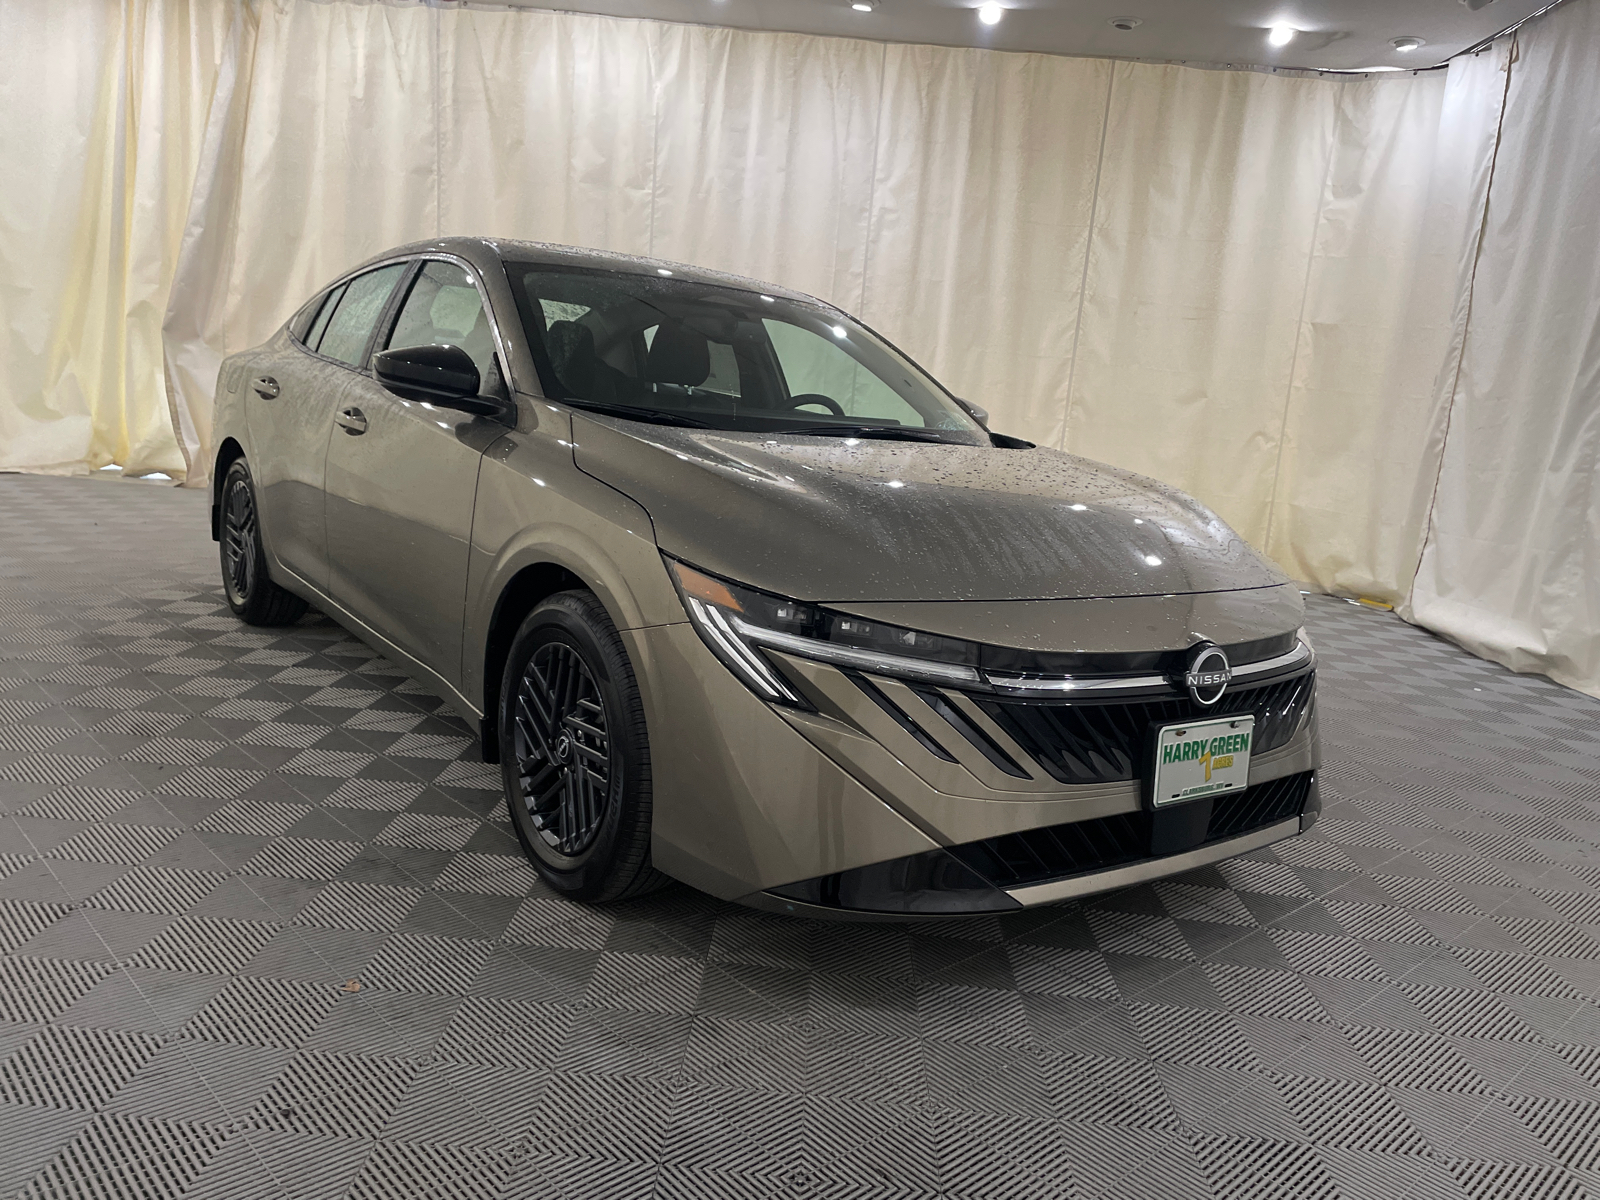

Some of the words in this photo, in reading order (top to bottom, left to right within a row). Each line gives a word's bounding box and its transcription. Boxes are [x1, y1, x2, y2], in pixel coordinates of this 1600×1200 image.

[1188, 672, 1231, 685] NISSAN
[1163, 739, 1209, 764] HARRY
[1209, 733, 1250, 757] GREEN
